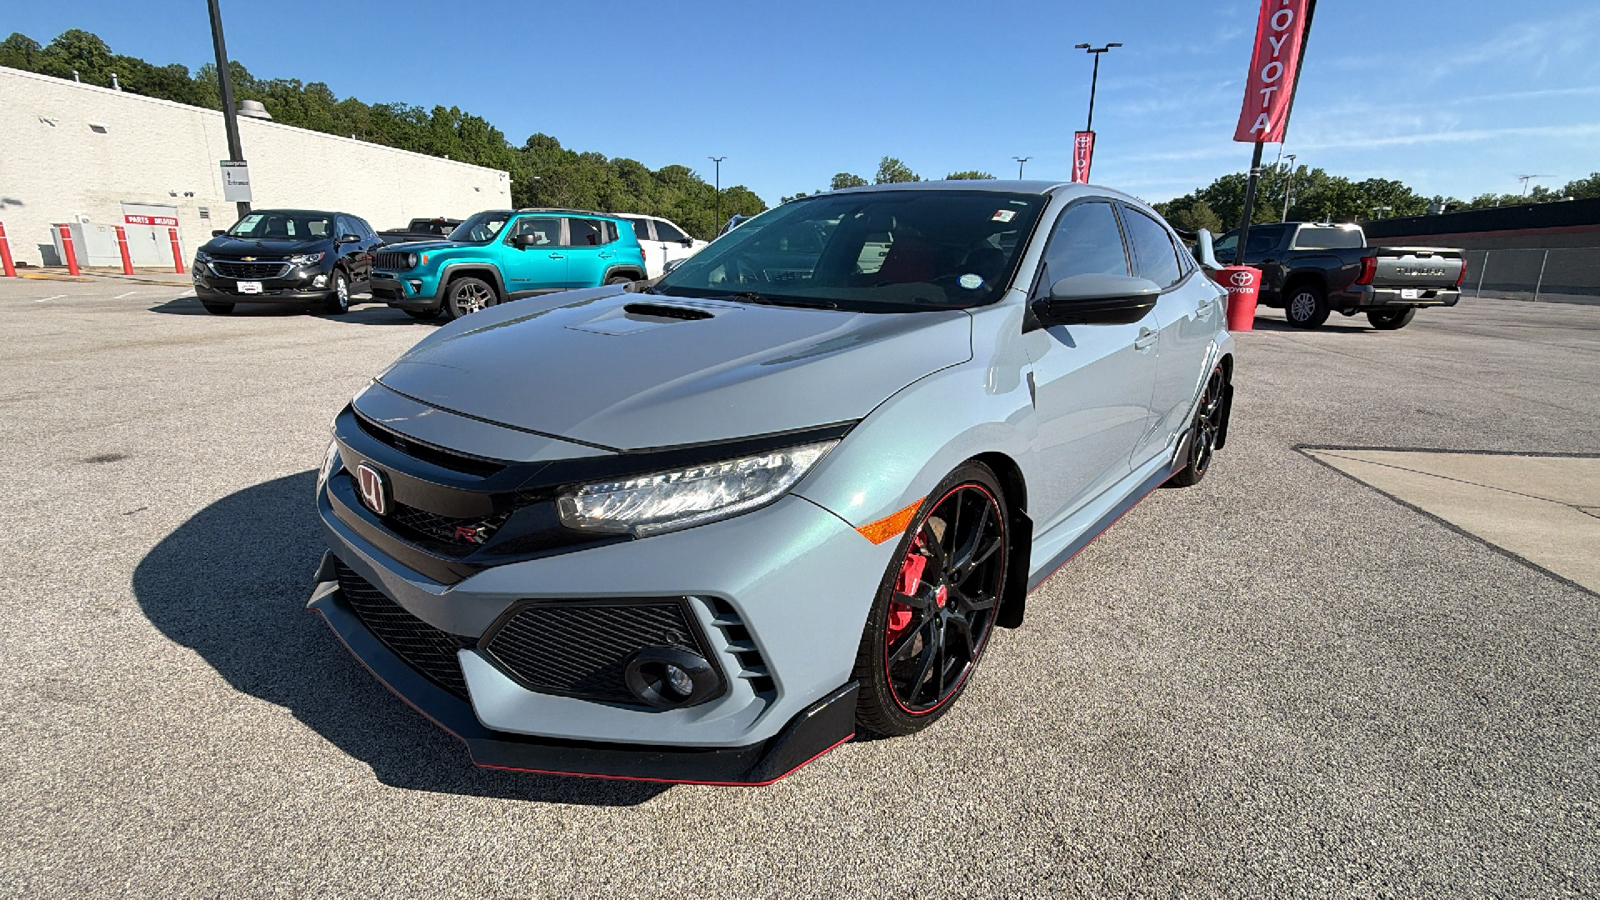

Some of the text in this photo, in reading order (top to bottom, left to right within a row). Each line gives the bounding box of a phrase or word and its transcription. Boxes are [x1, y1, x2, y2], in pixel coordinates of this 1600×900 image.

[1249, 0, 1294, 134] OYOTA
[128, 216, 176, 225] PARTS DELIVERY
[1396, 267, 1446, 276] TUNDRA
